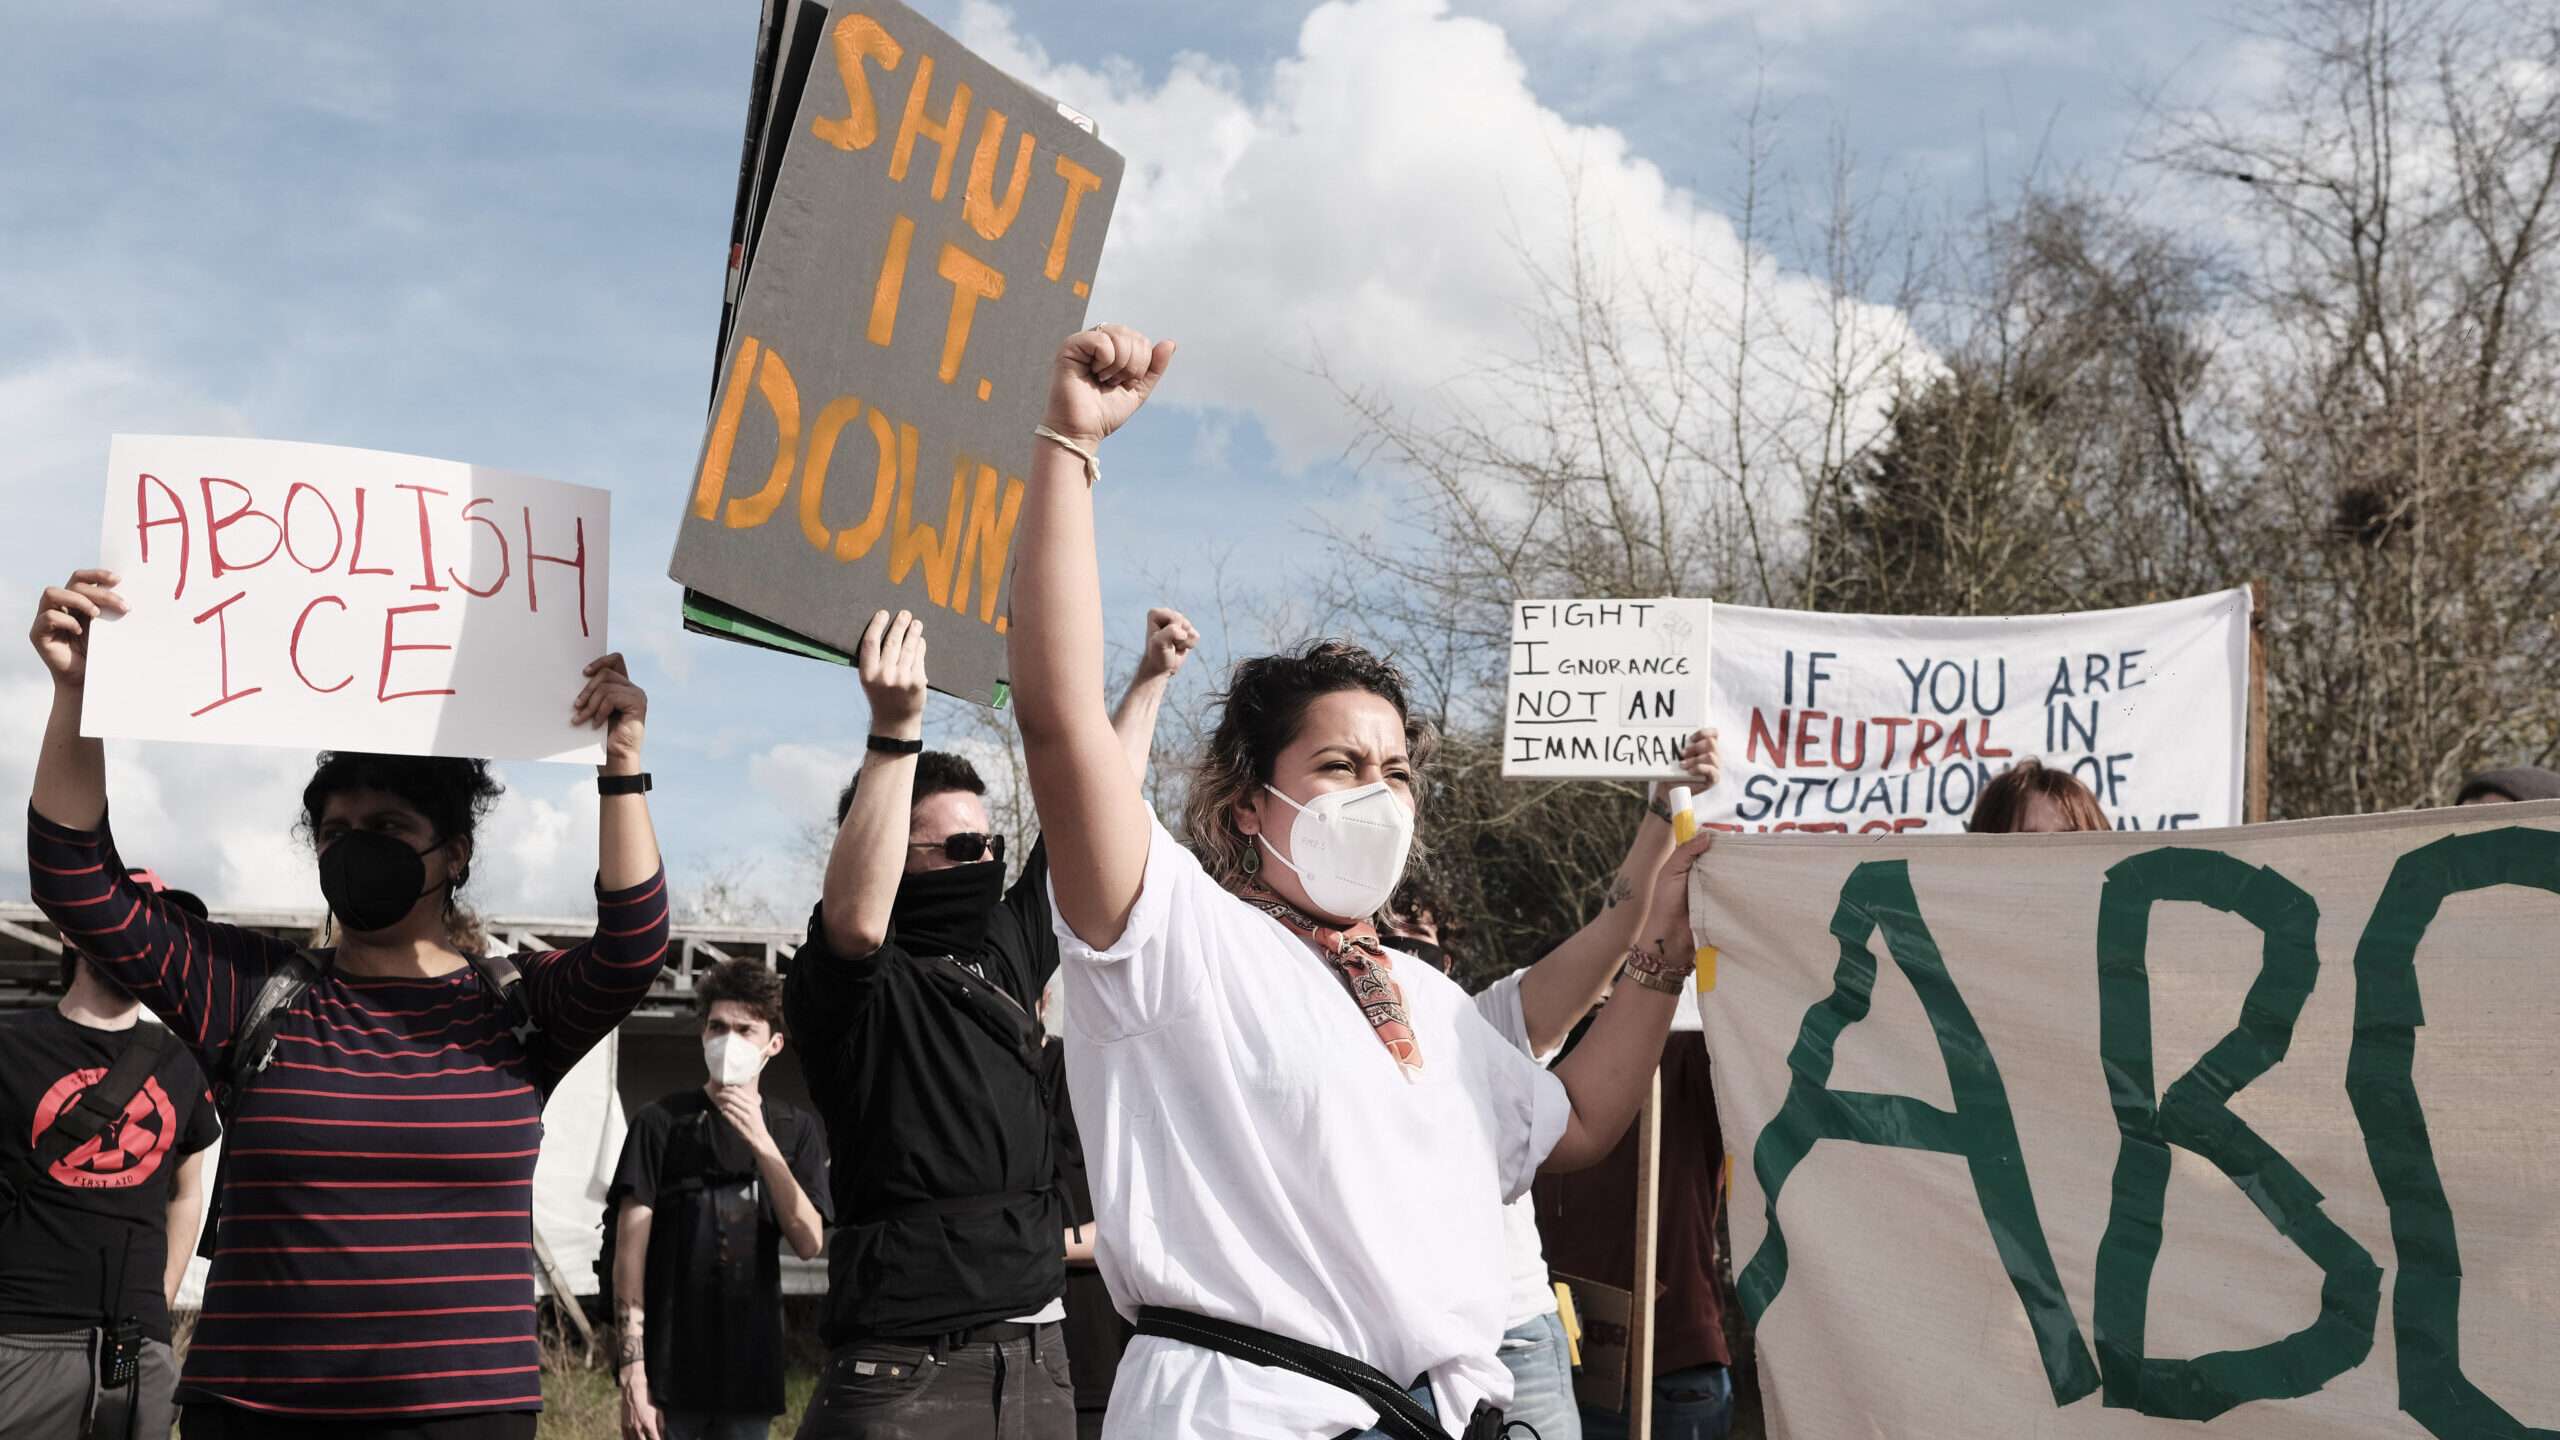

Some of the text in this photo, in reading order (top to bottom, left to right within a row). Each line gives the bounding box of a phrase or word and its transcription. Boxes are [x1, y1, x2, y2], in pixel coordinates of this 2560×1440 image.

[810, 13, 1101, 298] SHUT.
[866, 215, 1006, 401] IT.
[136, 473, 588, 636] ABOLISH
[1521, 603, 1655, 630] FIGHT
[191, 591, 456, 717] ICE
[1784, 649, 2147, 716] IF YOU ARE
[1517, 689, 1675, 720] NOT AN
[1746, 700, 2099, 770] NEUTRAL IN
[1512, 734, 1686, 766] IMMIGRAN
[2072, 753, 2133, 806] OF
[73, 1175, 134, 1188] FIRST AID
